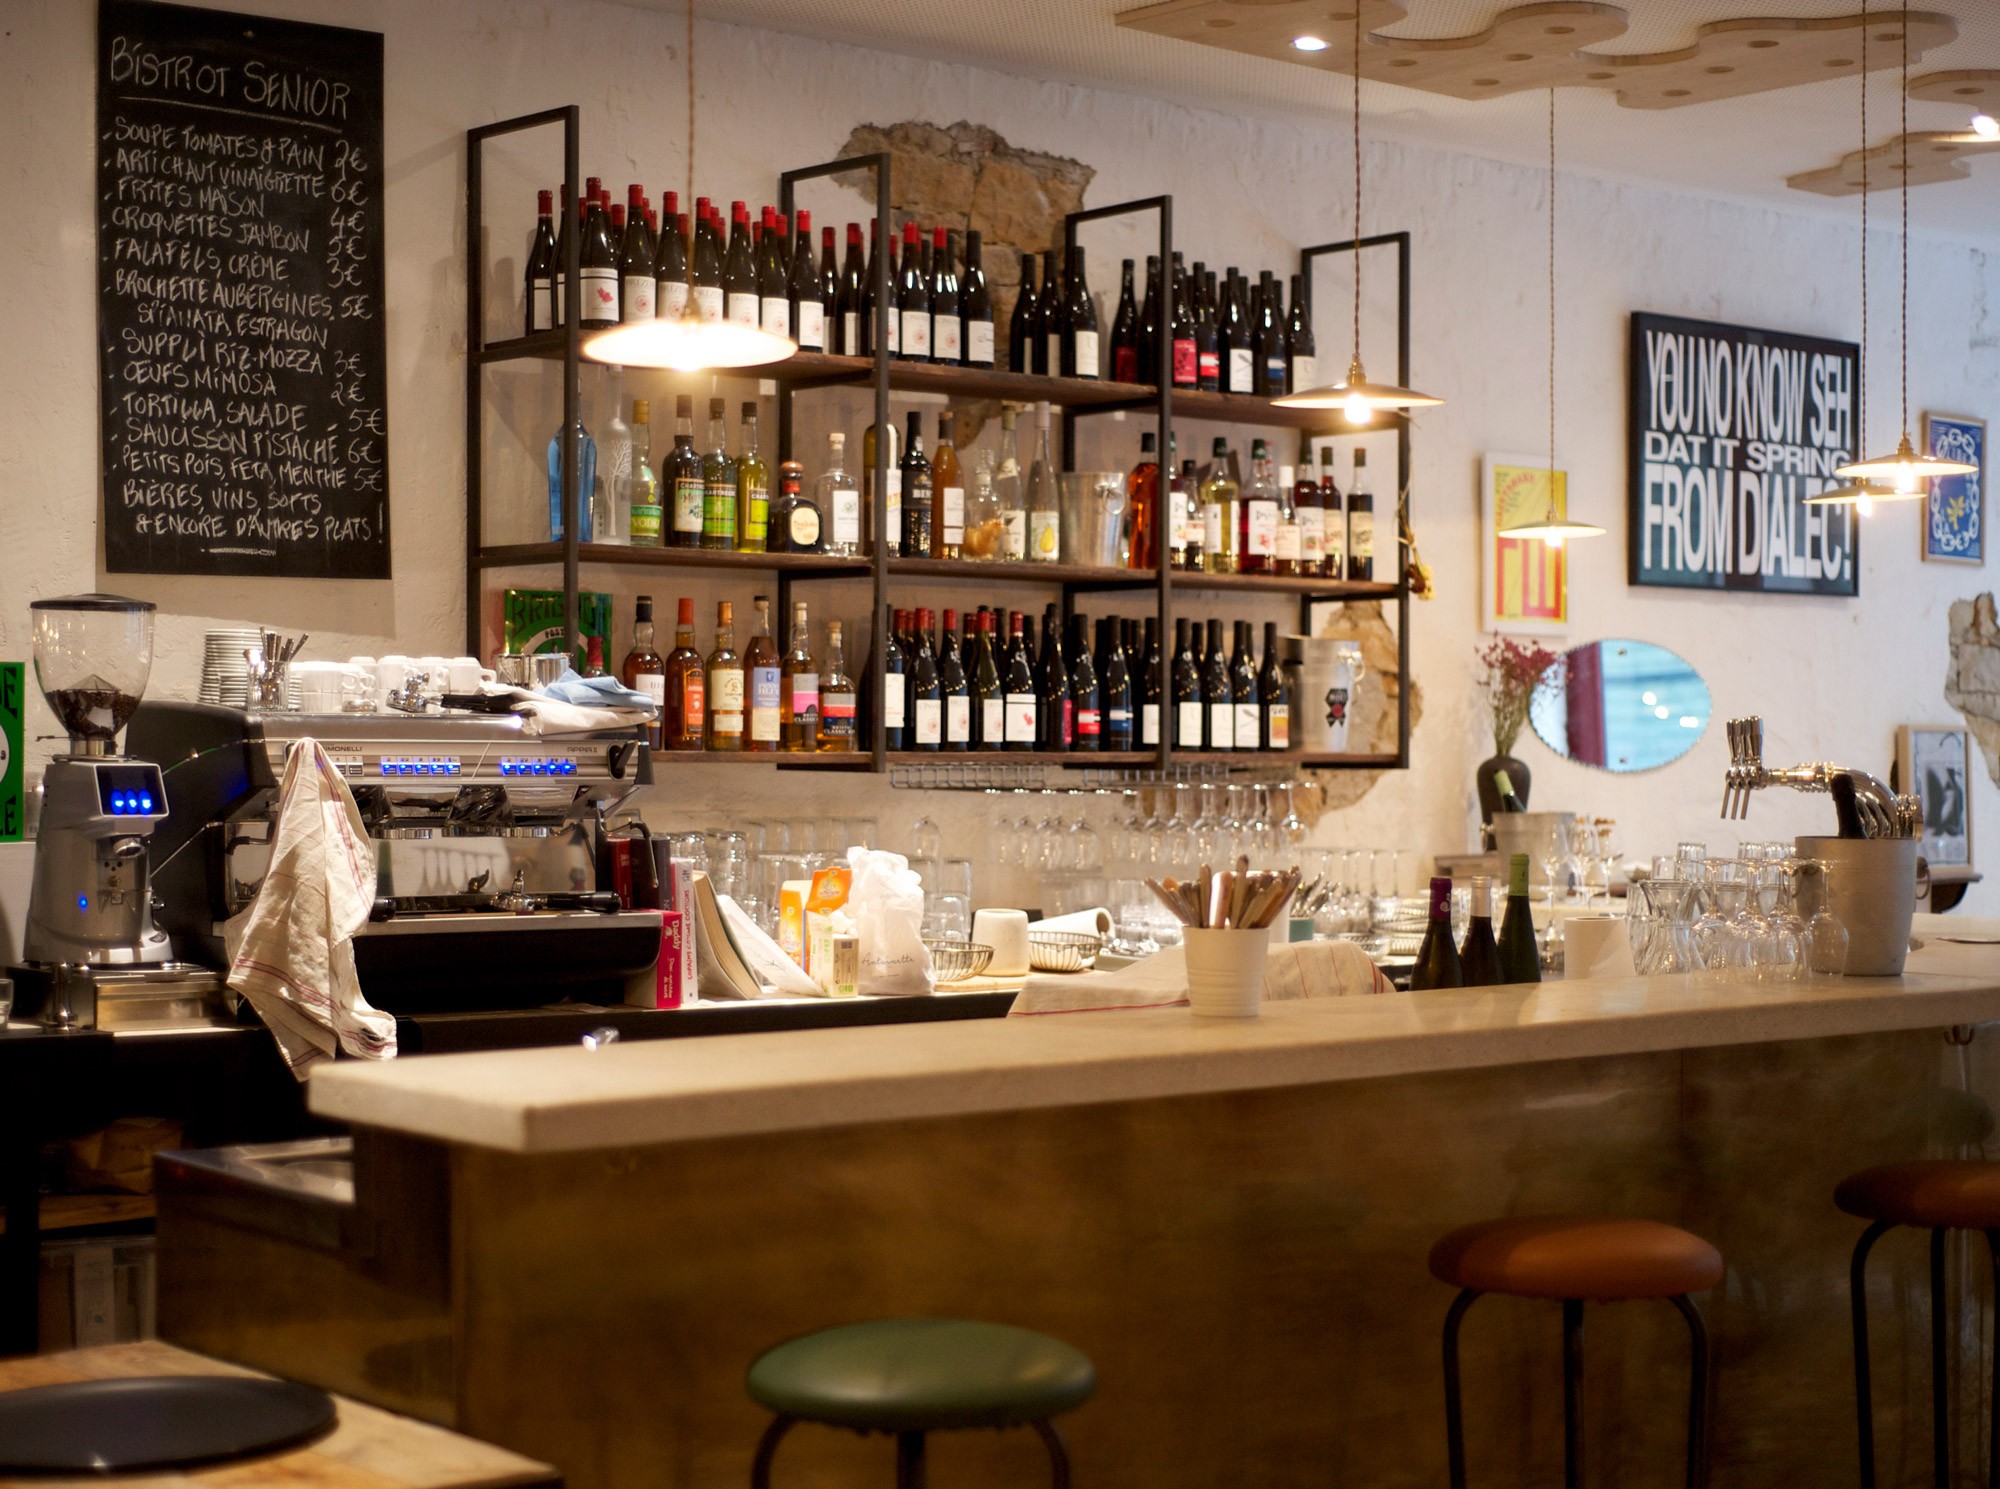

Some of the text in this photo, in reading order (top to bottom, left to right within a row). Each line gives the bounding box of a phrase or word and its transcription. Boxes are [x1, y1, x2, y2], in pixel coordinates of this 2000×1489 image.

[244, 61, 350, 119] SENIOR
[115, 116, 177, 148] SOUPE
[182, 125, 258, 158] TOMATES
[279, 135, 323, 171] PAIN
[116, 148, 217, 184] ARTICHAUT
[112, 205, 232, 238] CROQUETTES
[236, 221, 309, 253] JAMBON
[116, 268, 210, 303] BROCHETTE
[237, 313, 328, 350] ESTRAGON
[195, 364, 276, 396] MIMOSA
[1646, 329, 1852, 449] YOU NO KNOW SEH
[227, 401, 307, 432] SALADE
[126, 417, 247, 455] SAUCISSON
[1644, 430, 1851, 480] DAT IT SPRING
[123, 444, 180, 475] PETITS
[279, 460, 347, 490] MENTHE
[155, 512, 228, 538] ENCORE
[1644, 462, 1733, 575] FROM
[671, 919, 681, 950] Daddy
